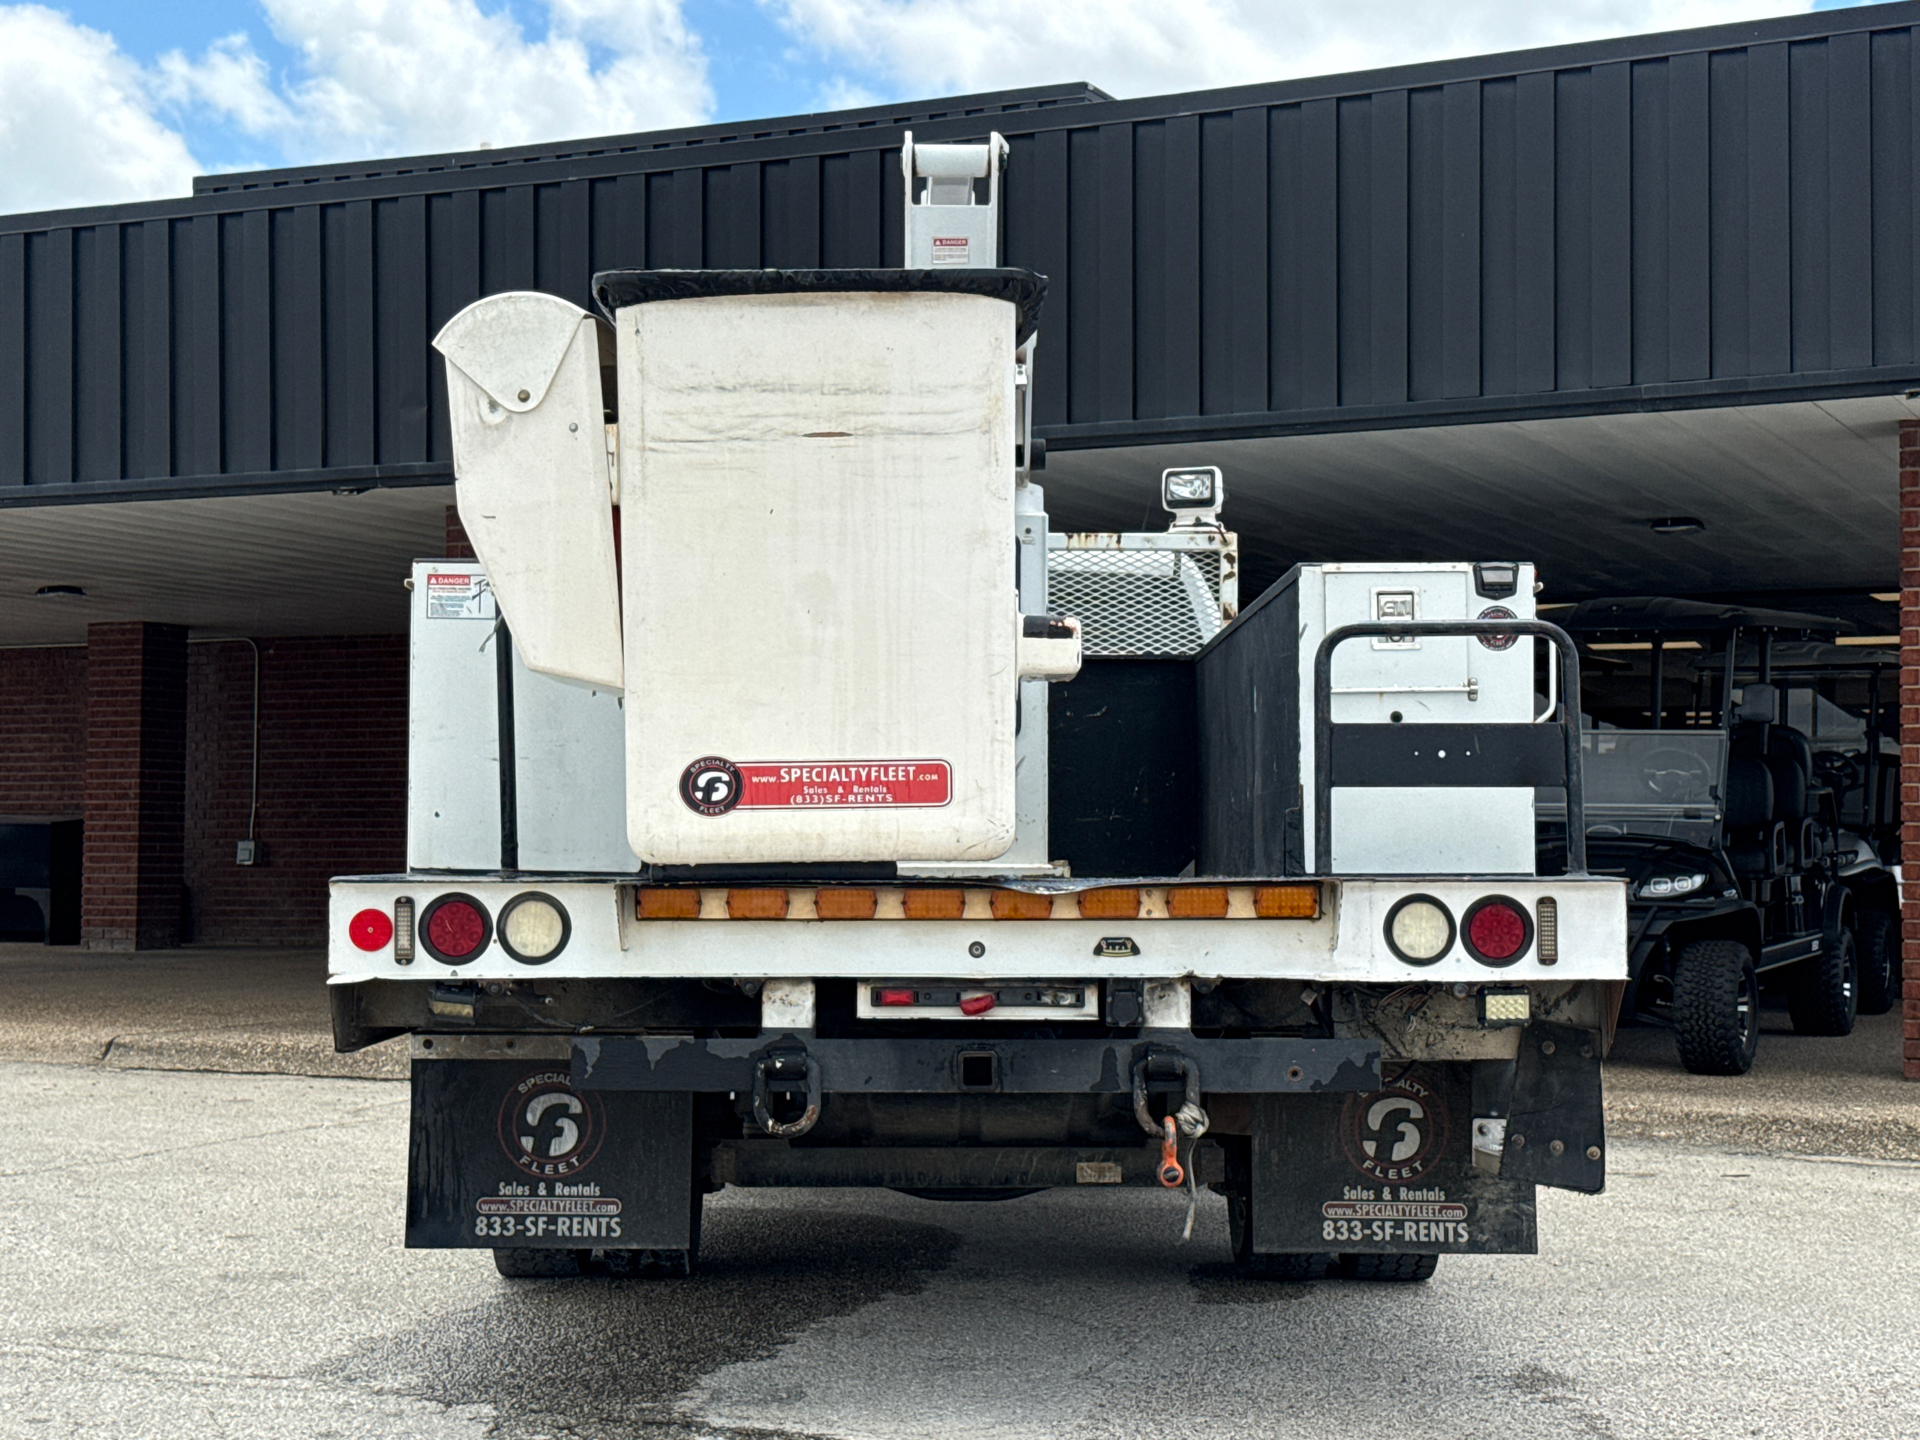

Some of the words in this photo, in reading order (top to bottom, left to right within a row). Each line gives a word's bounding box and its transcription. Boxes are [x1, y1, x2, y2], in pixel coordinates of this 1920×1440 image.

[690, 759, 735, 773] SPECIALTY
[803, 785, 828, 794] Sales
[837, 786, 844, 794] &
[853, 785, 887, 794] Rentals
[790, 794, 894, 805] (833)SF-RENTS
[699, 805, 725, 814] FLEET
[518, 1073, 572, 1094] SPECIAL
[519, 1155, 580, 1174] FLEET
[1362, 1160, 1423, 1179] FLEET
[498, 1181, 530, 1196] Sales
[537, 1182, 547, 1196] &
[555, 1182, 601, 1197] Rentals
[1343, 1185, 1375, 1200] Sales
[1382, 1186, 1392, 1200] &
[1400, 1186, 1446, 1201] Rentals
[481, 1200, 617, 1213] www.SPECIALTYFLEET.com
[1327, 1204, 1464, 1218] www.SPECIALTYFLEET.com
[474, 1215, 622, 1238] 833-SF-RENTS
[1322, 1220, 1469, 1243] 833-SF-RENTS
